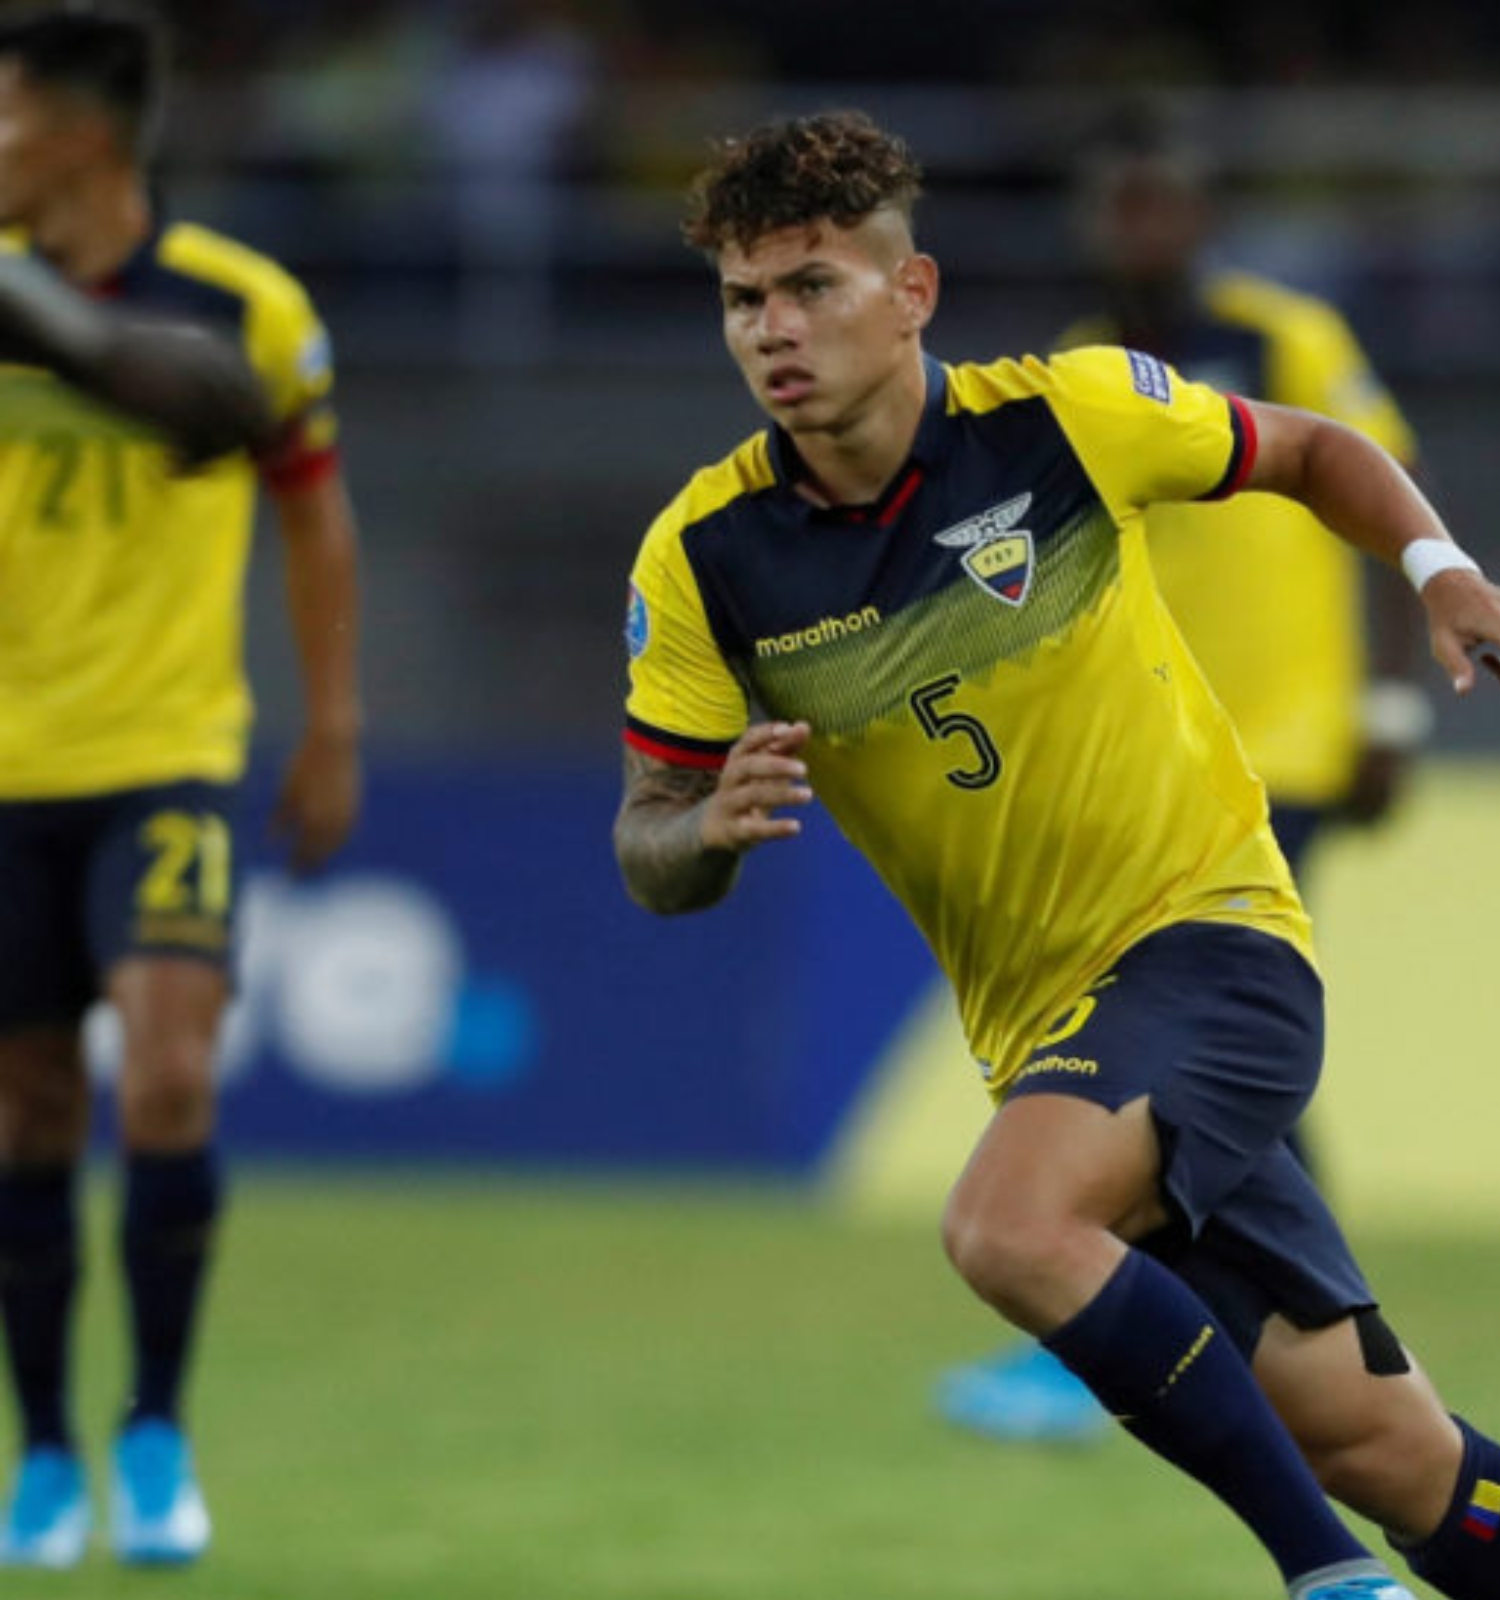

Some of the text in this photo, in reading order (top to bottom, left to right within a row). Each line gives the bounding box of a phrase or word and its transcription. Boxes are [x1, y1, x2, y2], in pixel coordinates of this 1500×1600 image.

[36, 430, 129, 531] 21
[755, 606, 881, 658] marathon
[910, 676, 1003, 790] 5
[140, 812, 232, 914] 21
